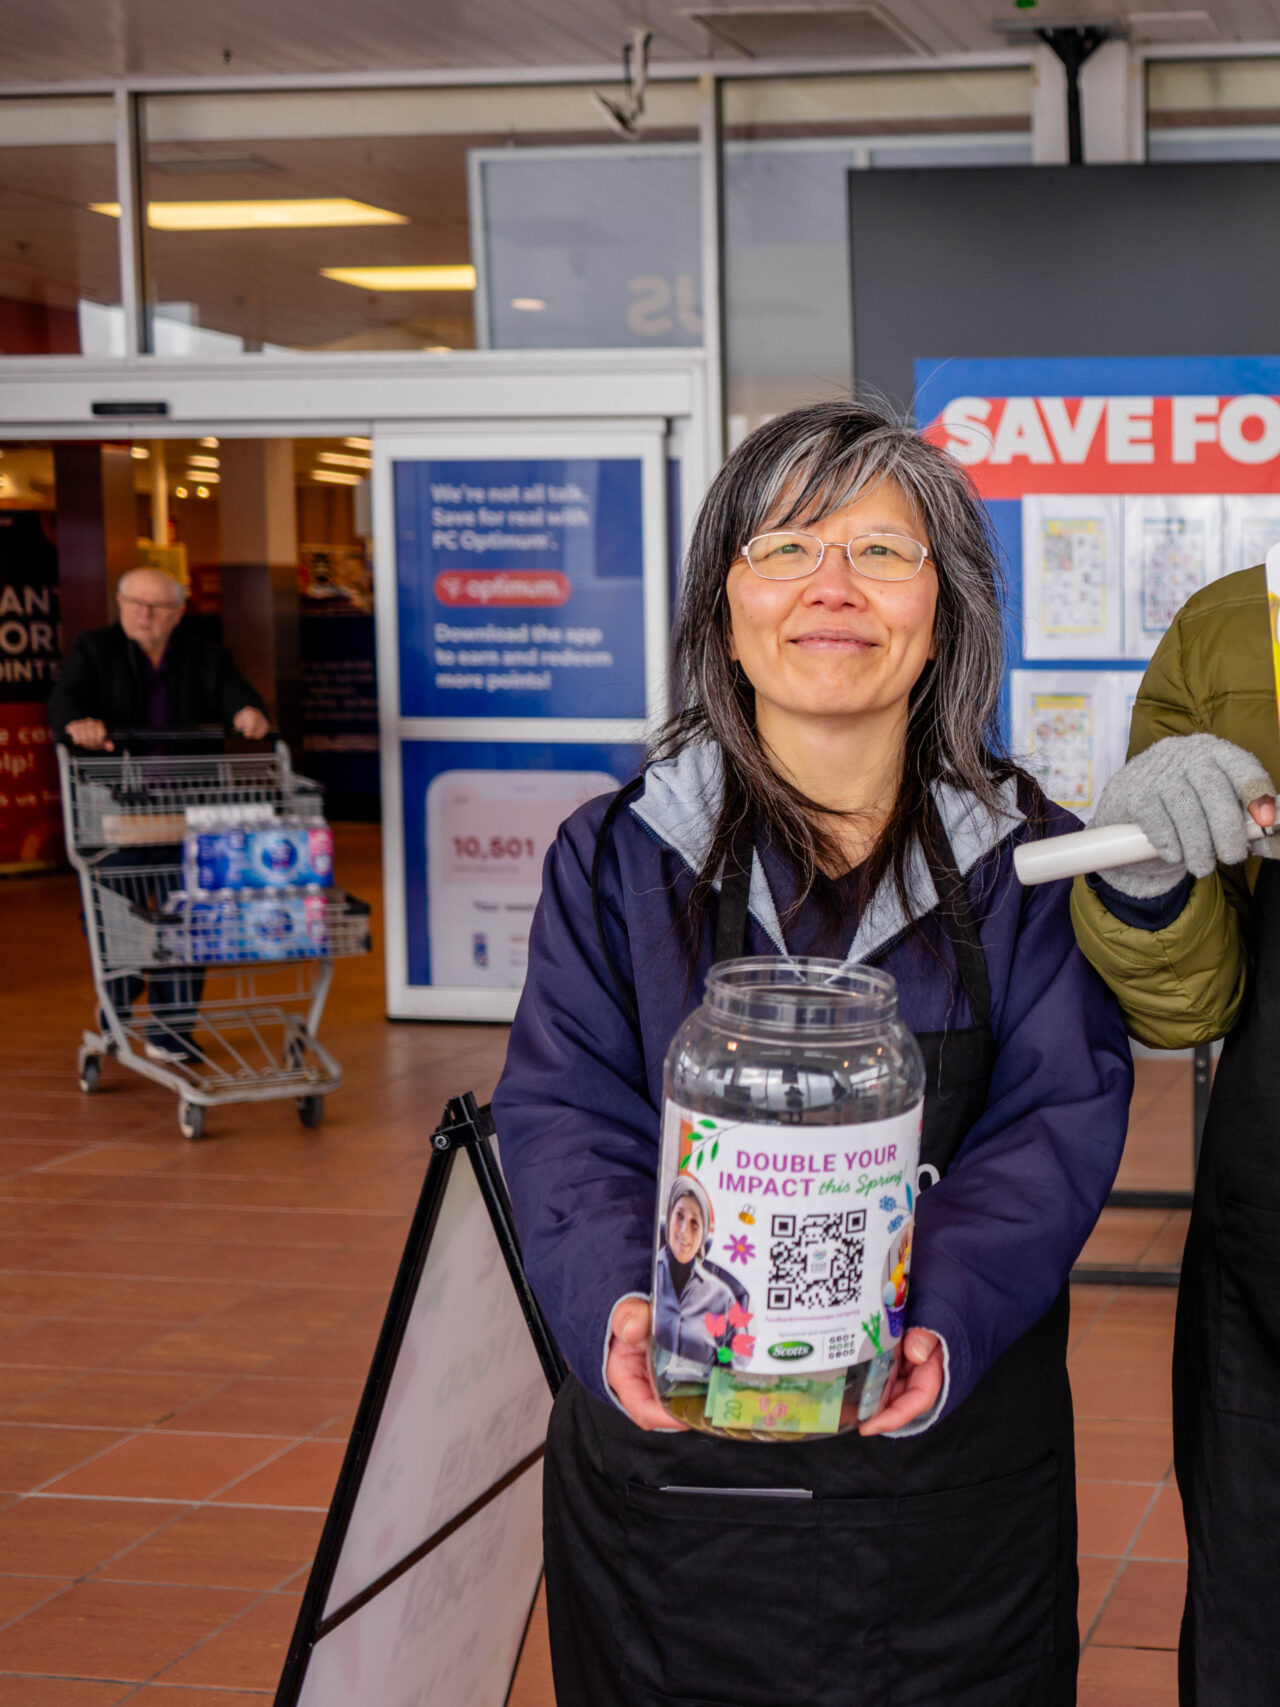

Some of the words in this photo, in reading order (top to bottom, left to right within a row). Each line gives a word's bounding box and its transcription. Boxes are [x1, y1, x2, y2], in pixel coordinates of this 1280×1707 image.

[942, 395, 1154, 466] SAVE
[488, 486, 520, 503] not
[523, 483, 545, 503] all
[432, 507, 476, 527] Save
[478, 507, 504, 527] for
[507, 507, 544, 527] real
[432, 531, 457, 549] PC
[434, 623, 529, 643] Download
[532, 624, 562, 643] the
[435, 649, 455, 666] to
[502, 648, 538, 666] and
[436, 672, 484, 689] more
[736, 1150, 836, 1174] DOUBLE
[843, 1143, 898, 1170] YOUR
[718, 1171, 816, 1197] IMPACT
[818, 1175, 850, 1195] this
[855, 1162, 908, 1196] Spring!
[773, 1344, 810, 1358] Scotts
[829, 1341, 855, 1352] MORE
[723, 1398, 743, 1421] 20
